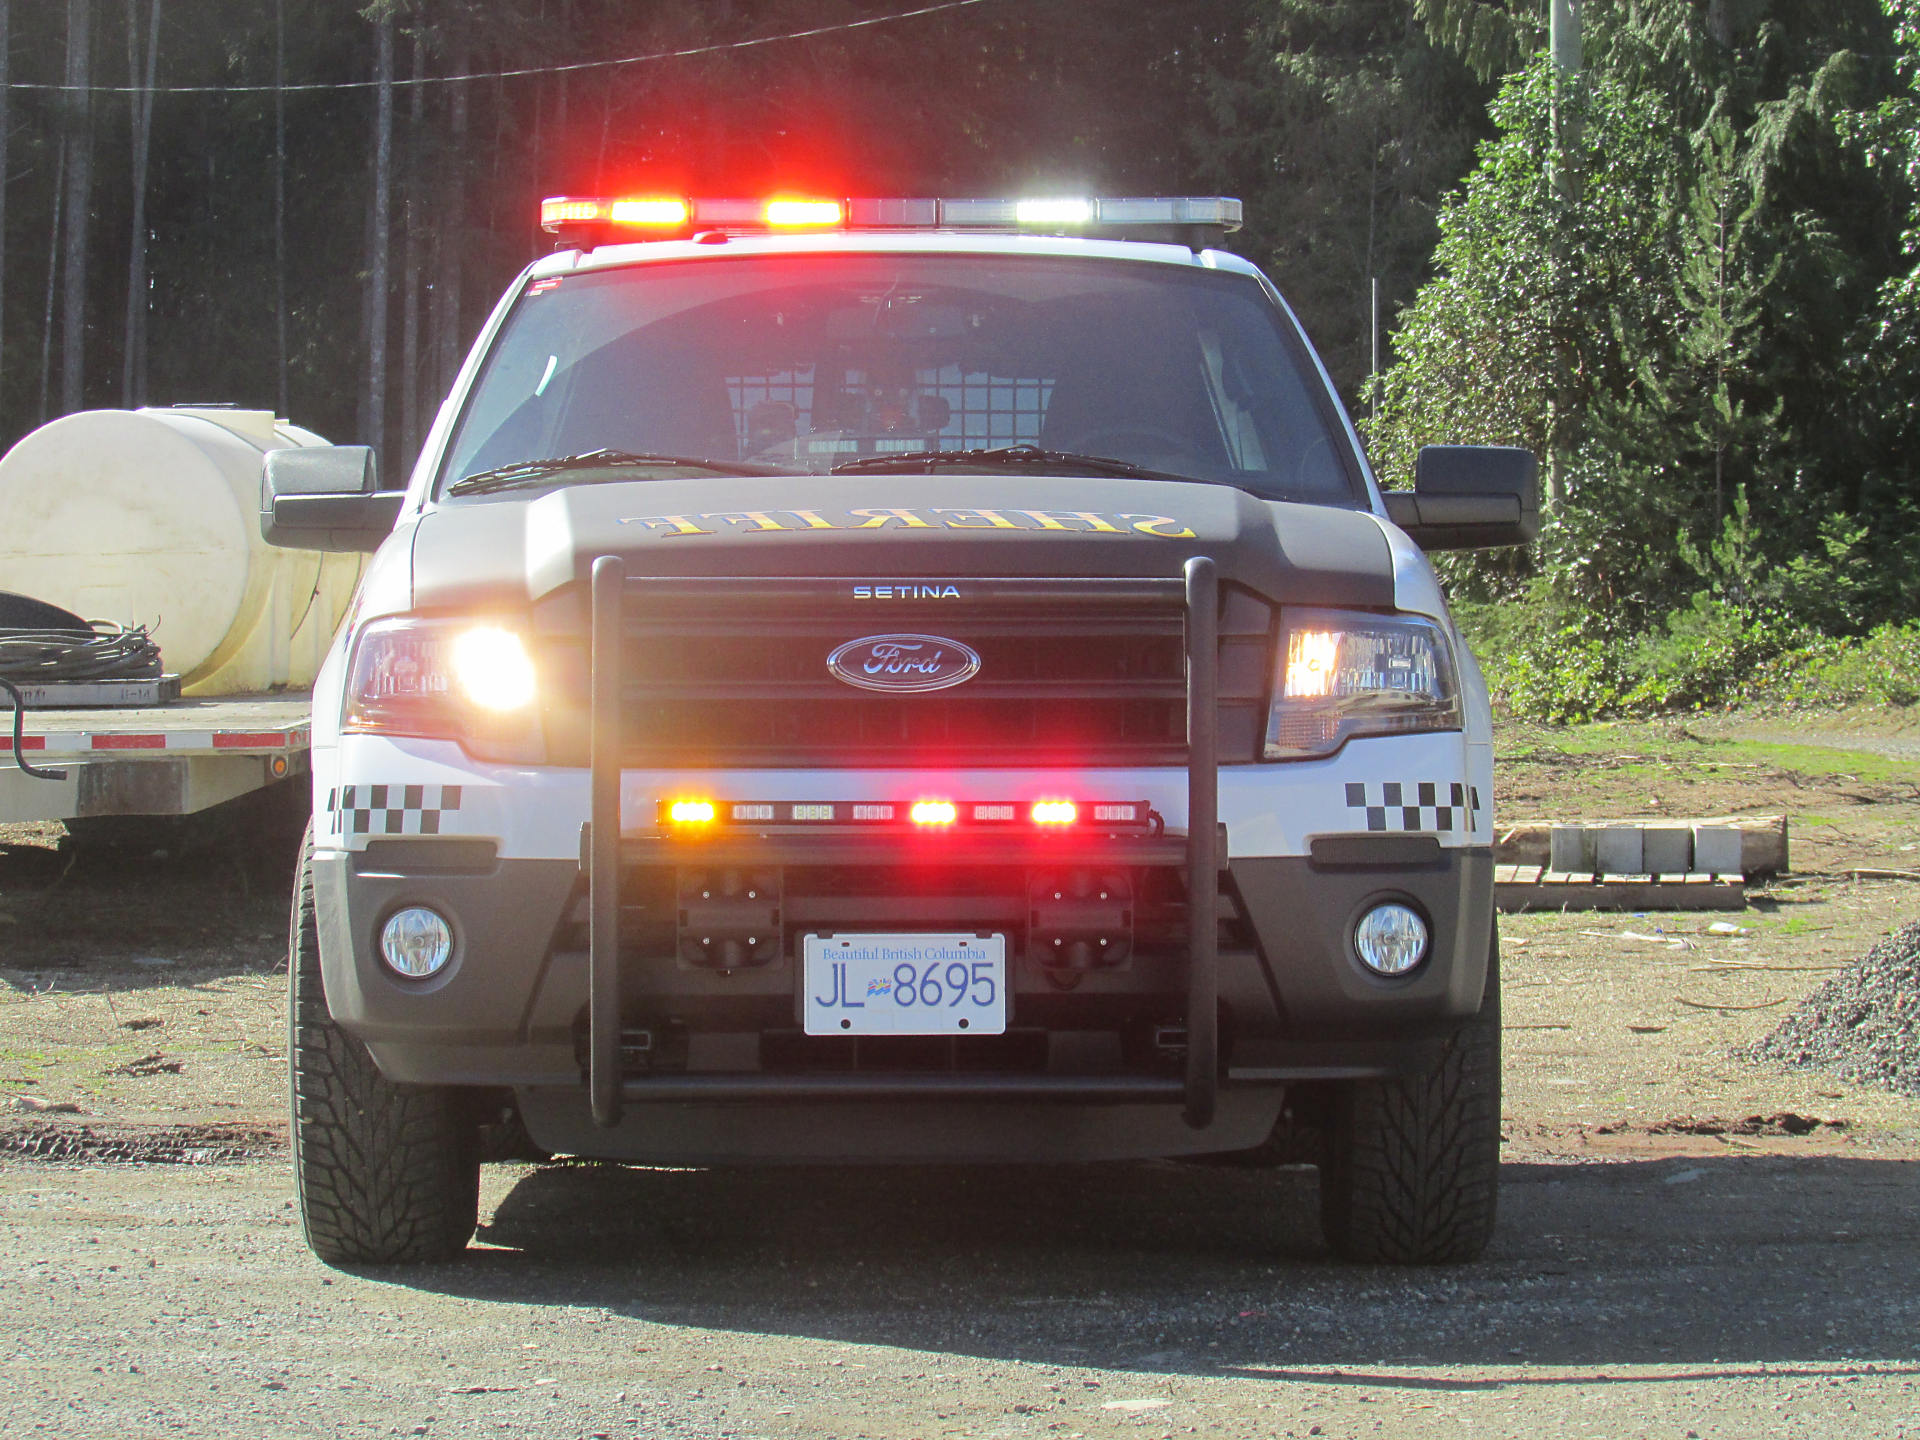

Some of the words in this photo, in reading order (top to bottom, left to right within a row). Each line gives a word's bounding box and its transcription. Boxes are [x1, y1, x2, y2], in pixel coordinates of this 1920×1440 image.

[853, 585, 961, 599] SETINA
[863, 643, 942, 674] Ford
[823, 947, 878, 960] Beautiful
[882, 947, 922, 960] British
[924, 947, 986, 960] Columbia
[815, 963, 865, 1008] JL
[893, 962, 995, 1008] 8695
